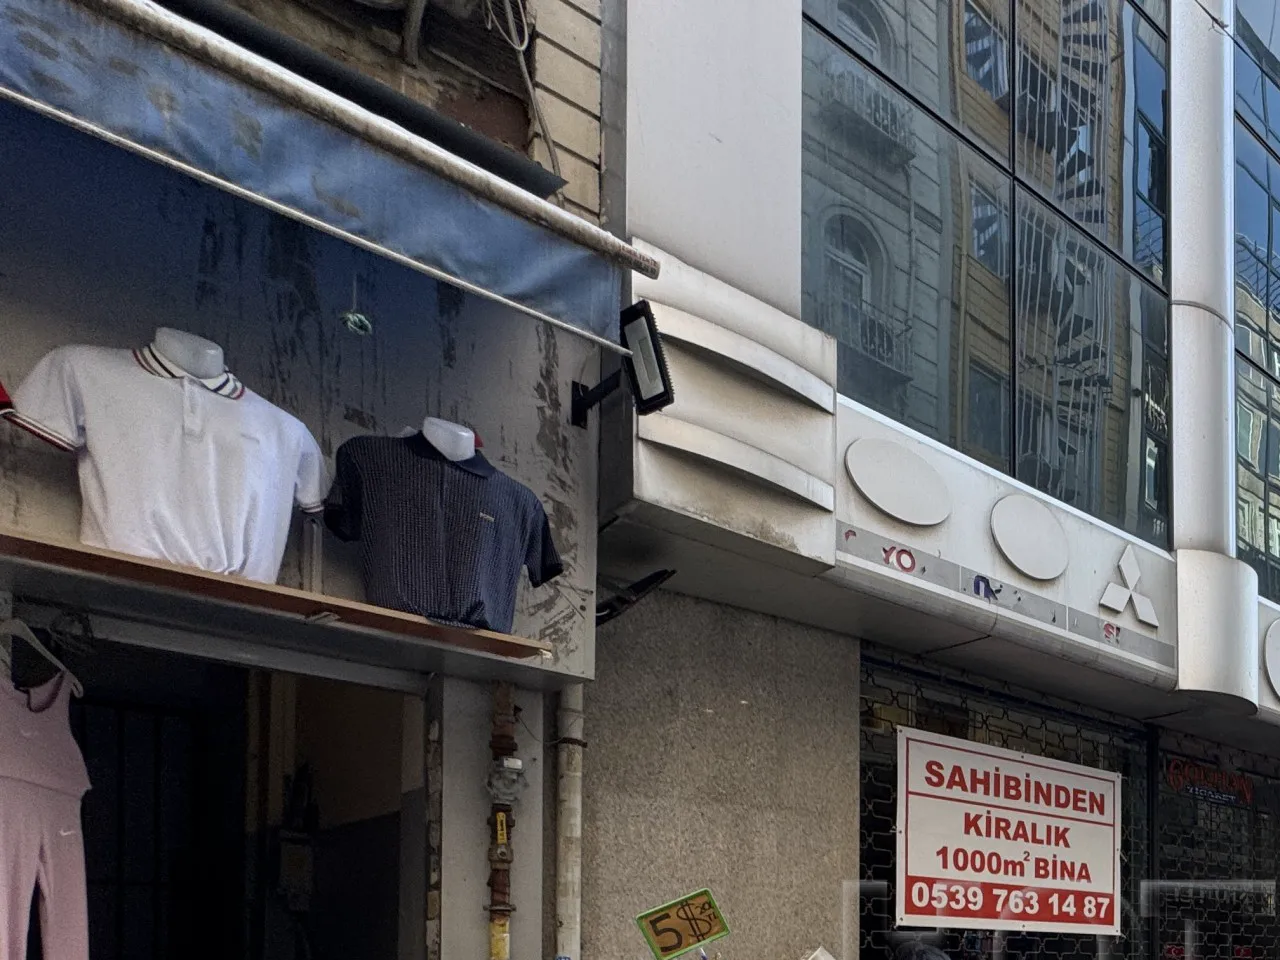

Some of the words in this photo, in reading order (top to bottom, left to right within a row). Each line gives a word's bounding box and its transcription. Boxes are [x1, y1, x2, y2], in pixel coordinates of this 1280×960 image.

[924, 760, 1105, 816] SAHİBİNDEN
[964, 810, 1071, 848] KİRALIK
[1034, 854, 1092, 883] BİNA
[911, 882, 984, 911] 0539
[992, 888, 1039, 915] 763
[1048, 893, 1077, 916] 14
[1083, 896, 1110, 919] 87
